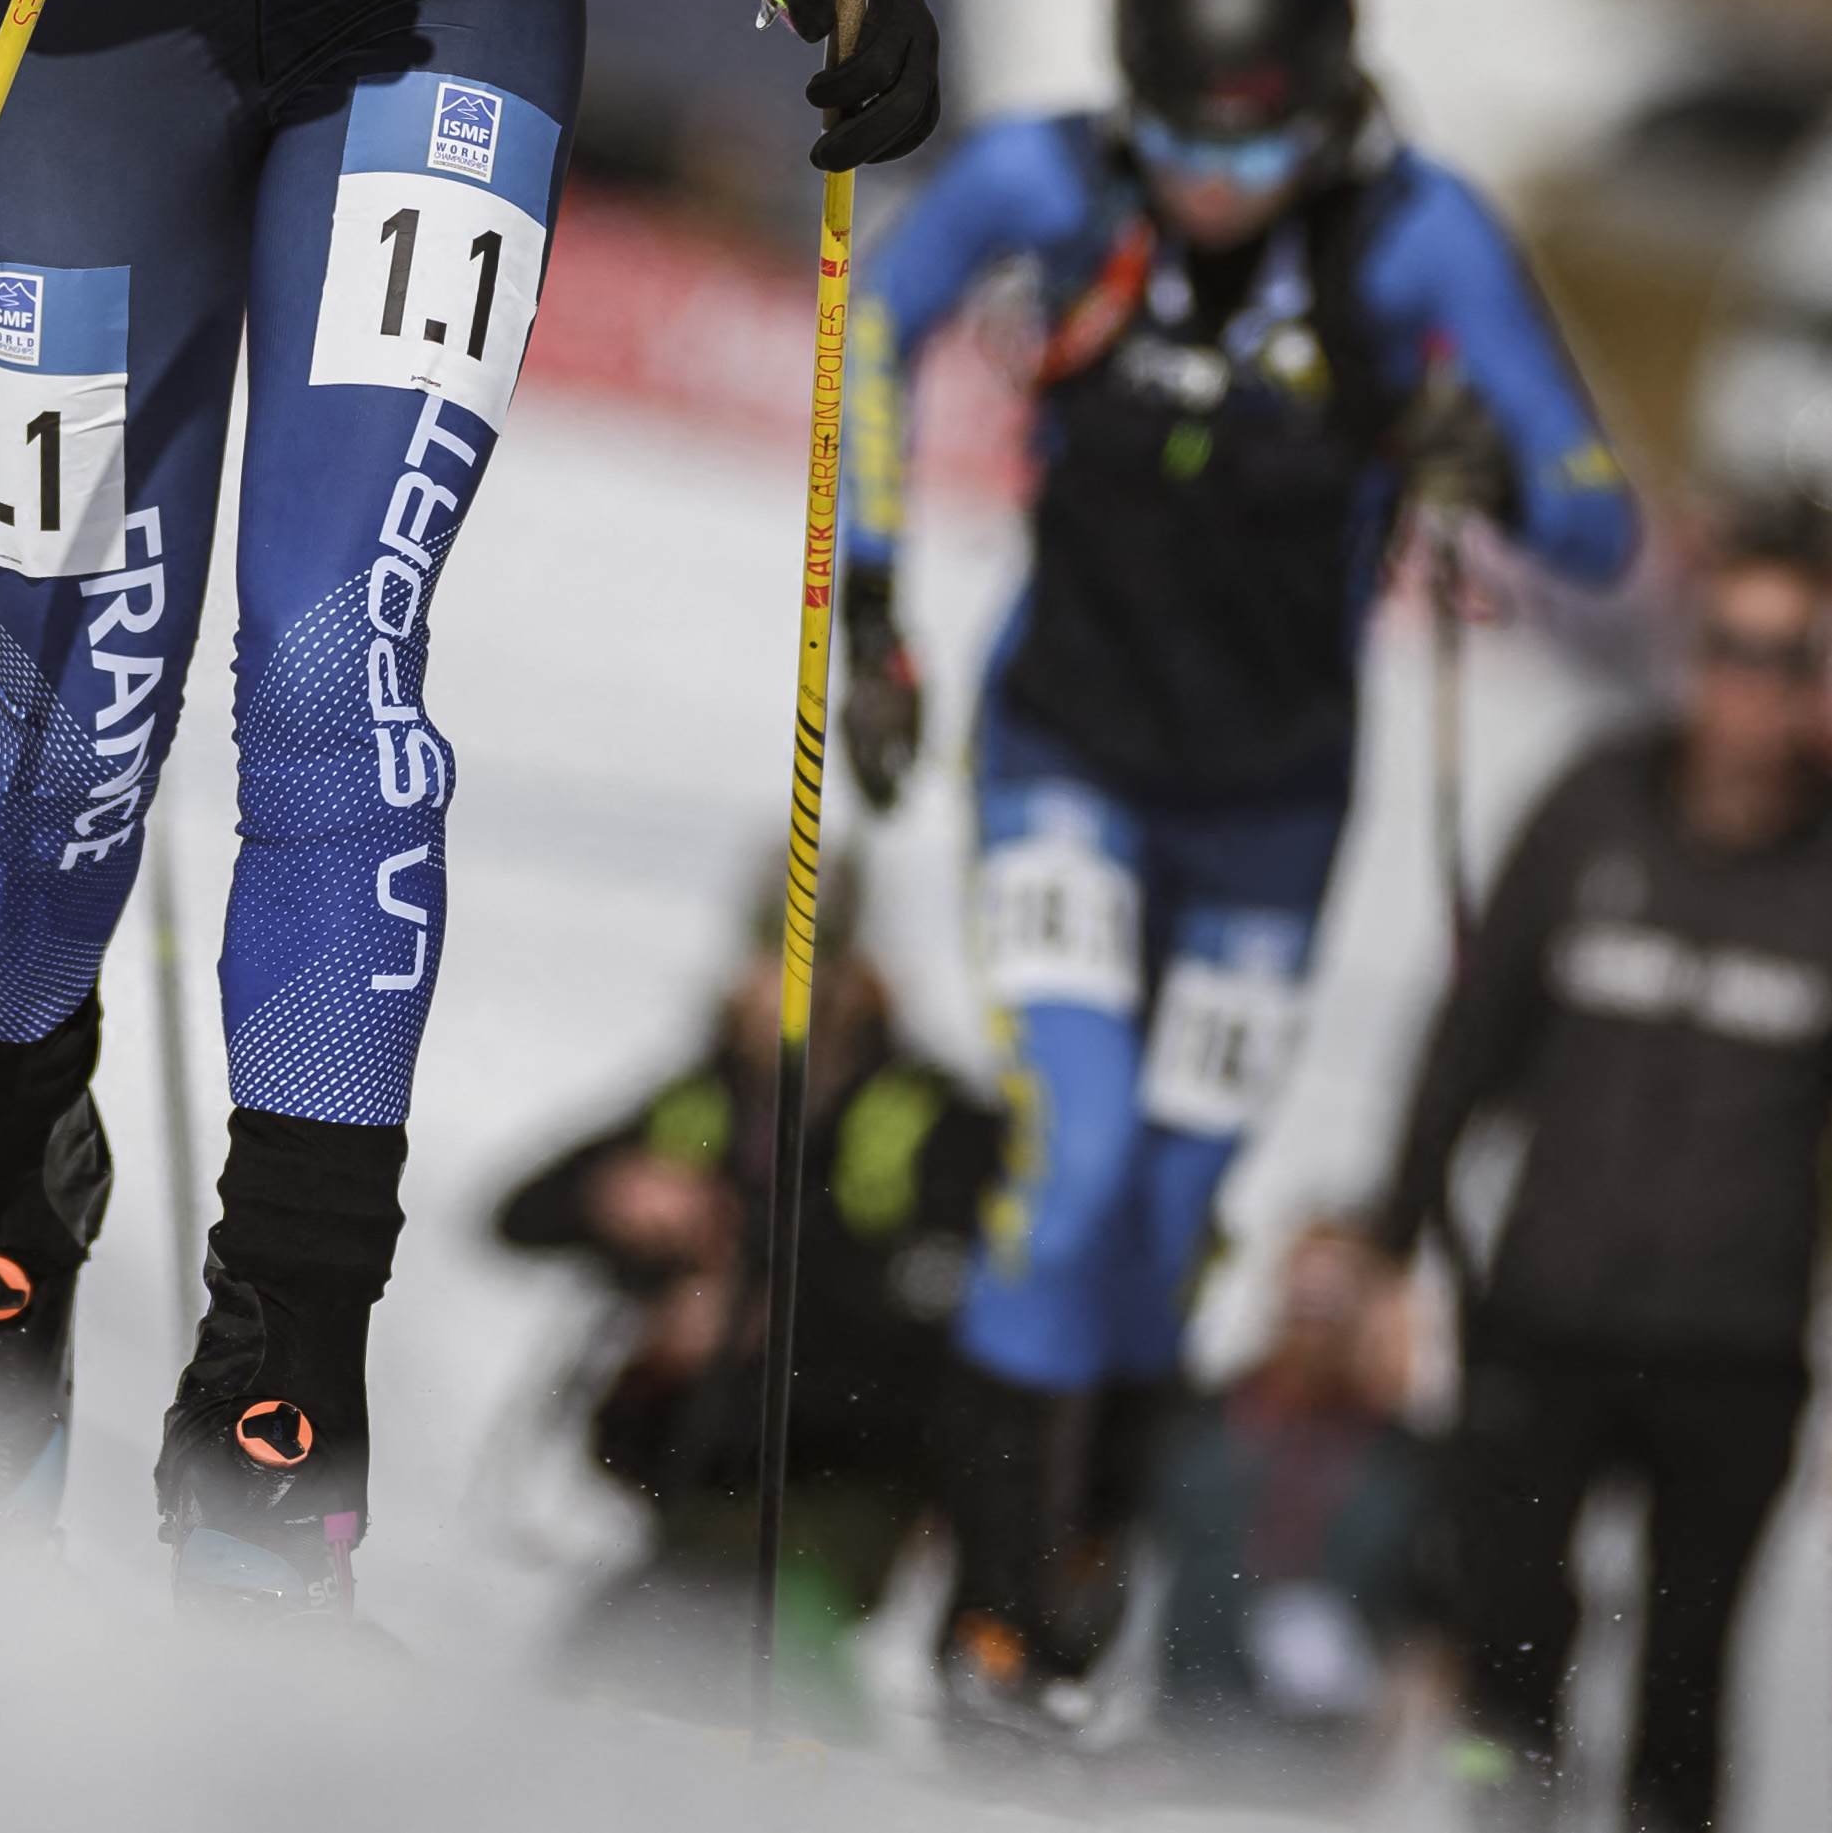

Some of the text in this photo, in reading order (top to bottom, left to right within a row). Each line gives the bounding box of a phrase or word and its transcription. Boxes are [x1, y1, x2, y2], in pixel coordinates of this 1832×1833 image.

[435, 141, 490, 164] WORLD
[442, 118, 491, 144] ISMF
[380, 208, 503, 361] 1.1
[805, 301, 846, 577] ATK CARBON POLES
[58, 505, 168, 871] FRANCE
[365, 395, 478, 993] LA SPORT
